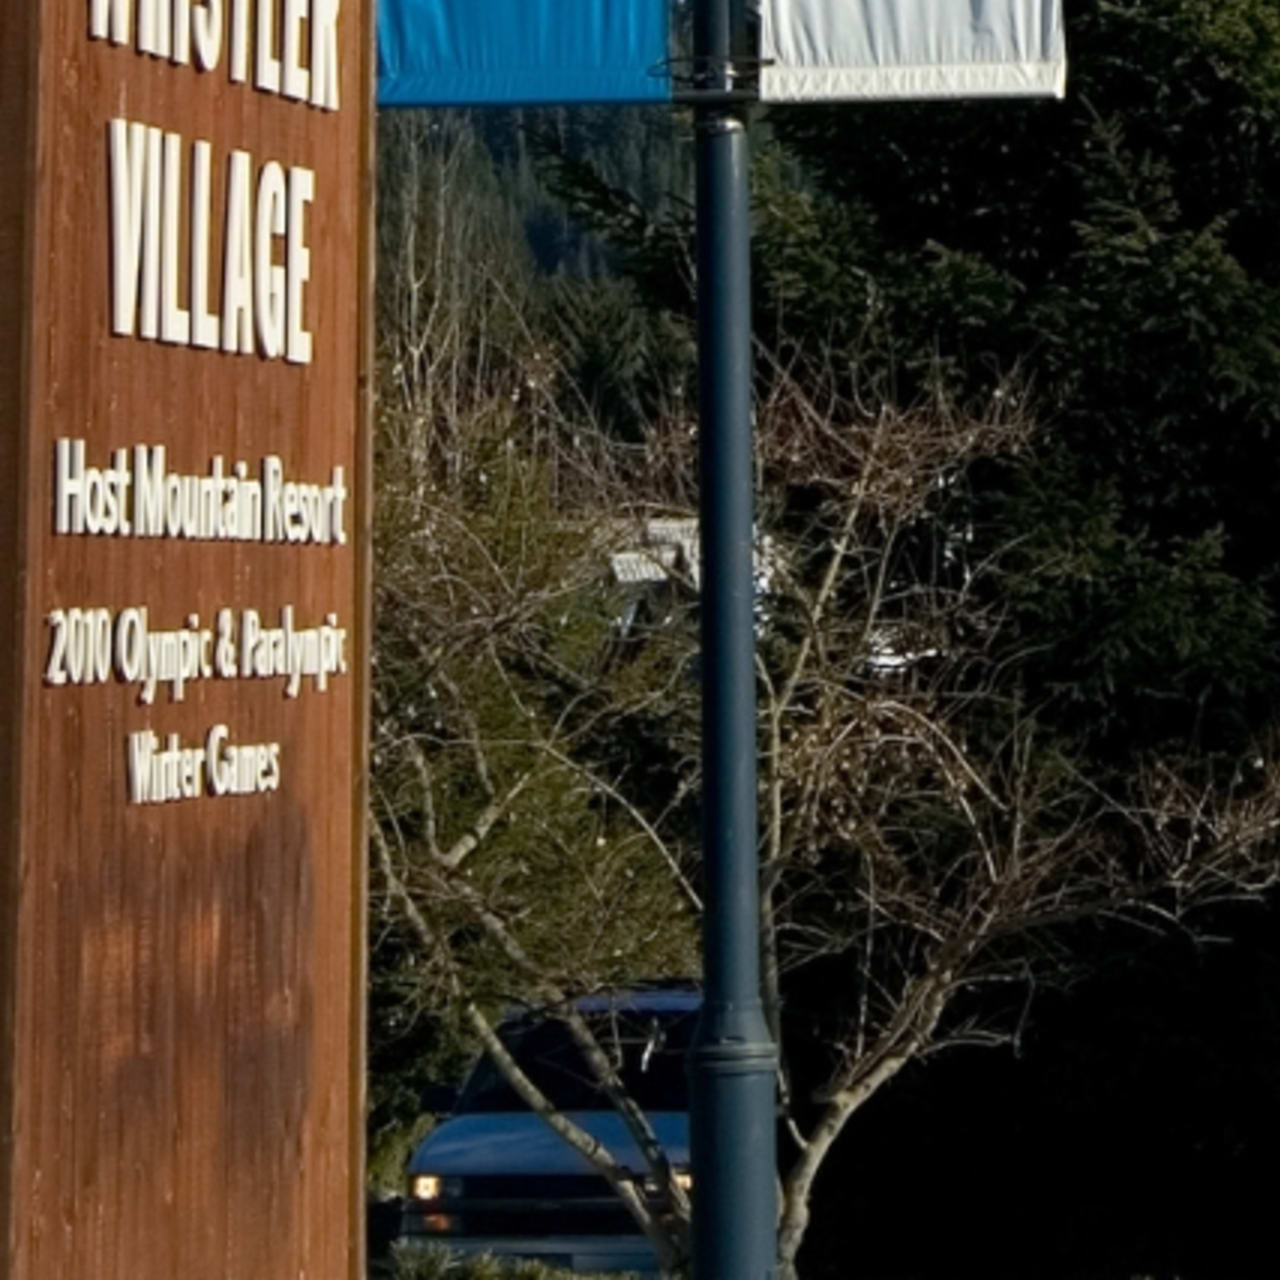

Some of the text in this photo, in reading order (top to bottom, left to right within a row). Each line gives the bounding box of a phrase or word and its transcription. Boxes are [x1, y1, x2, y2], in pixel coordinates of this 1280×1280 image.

[109, 118, 315, 364] VILLAGE
[55, 437, 347, 544] Host Mountain Resort
[46, 605, 347, 704] 2010 Olympic & Paralympic
[128, 724, 280, 804] Winter Games
